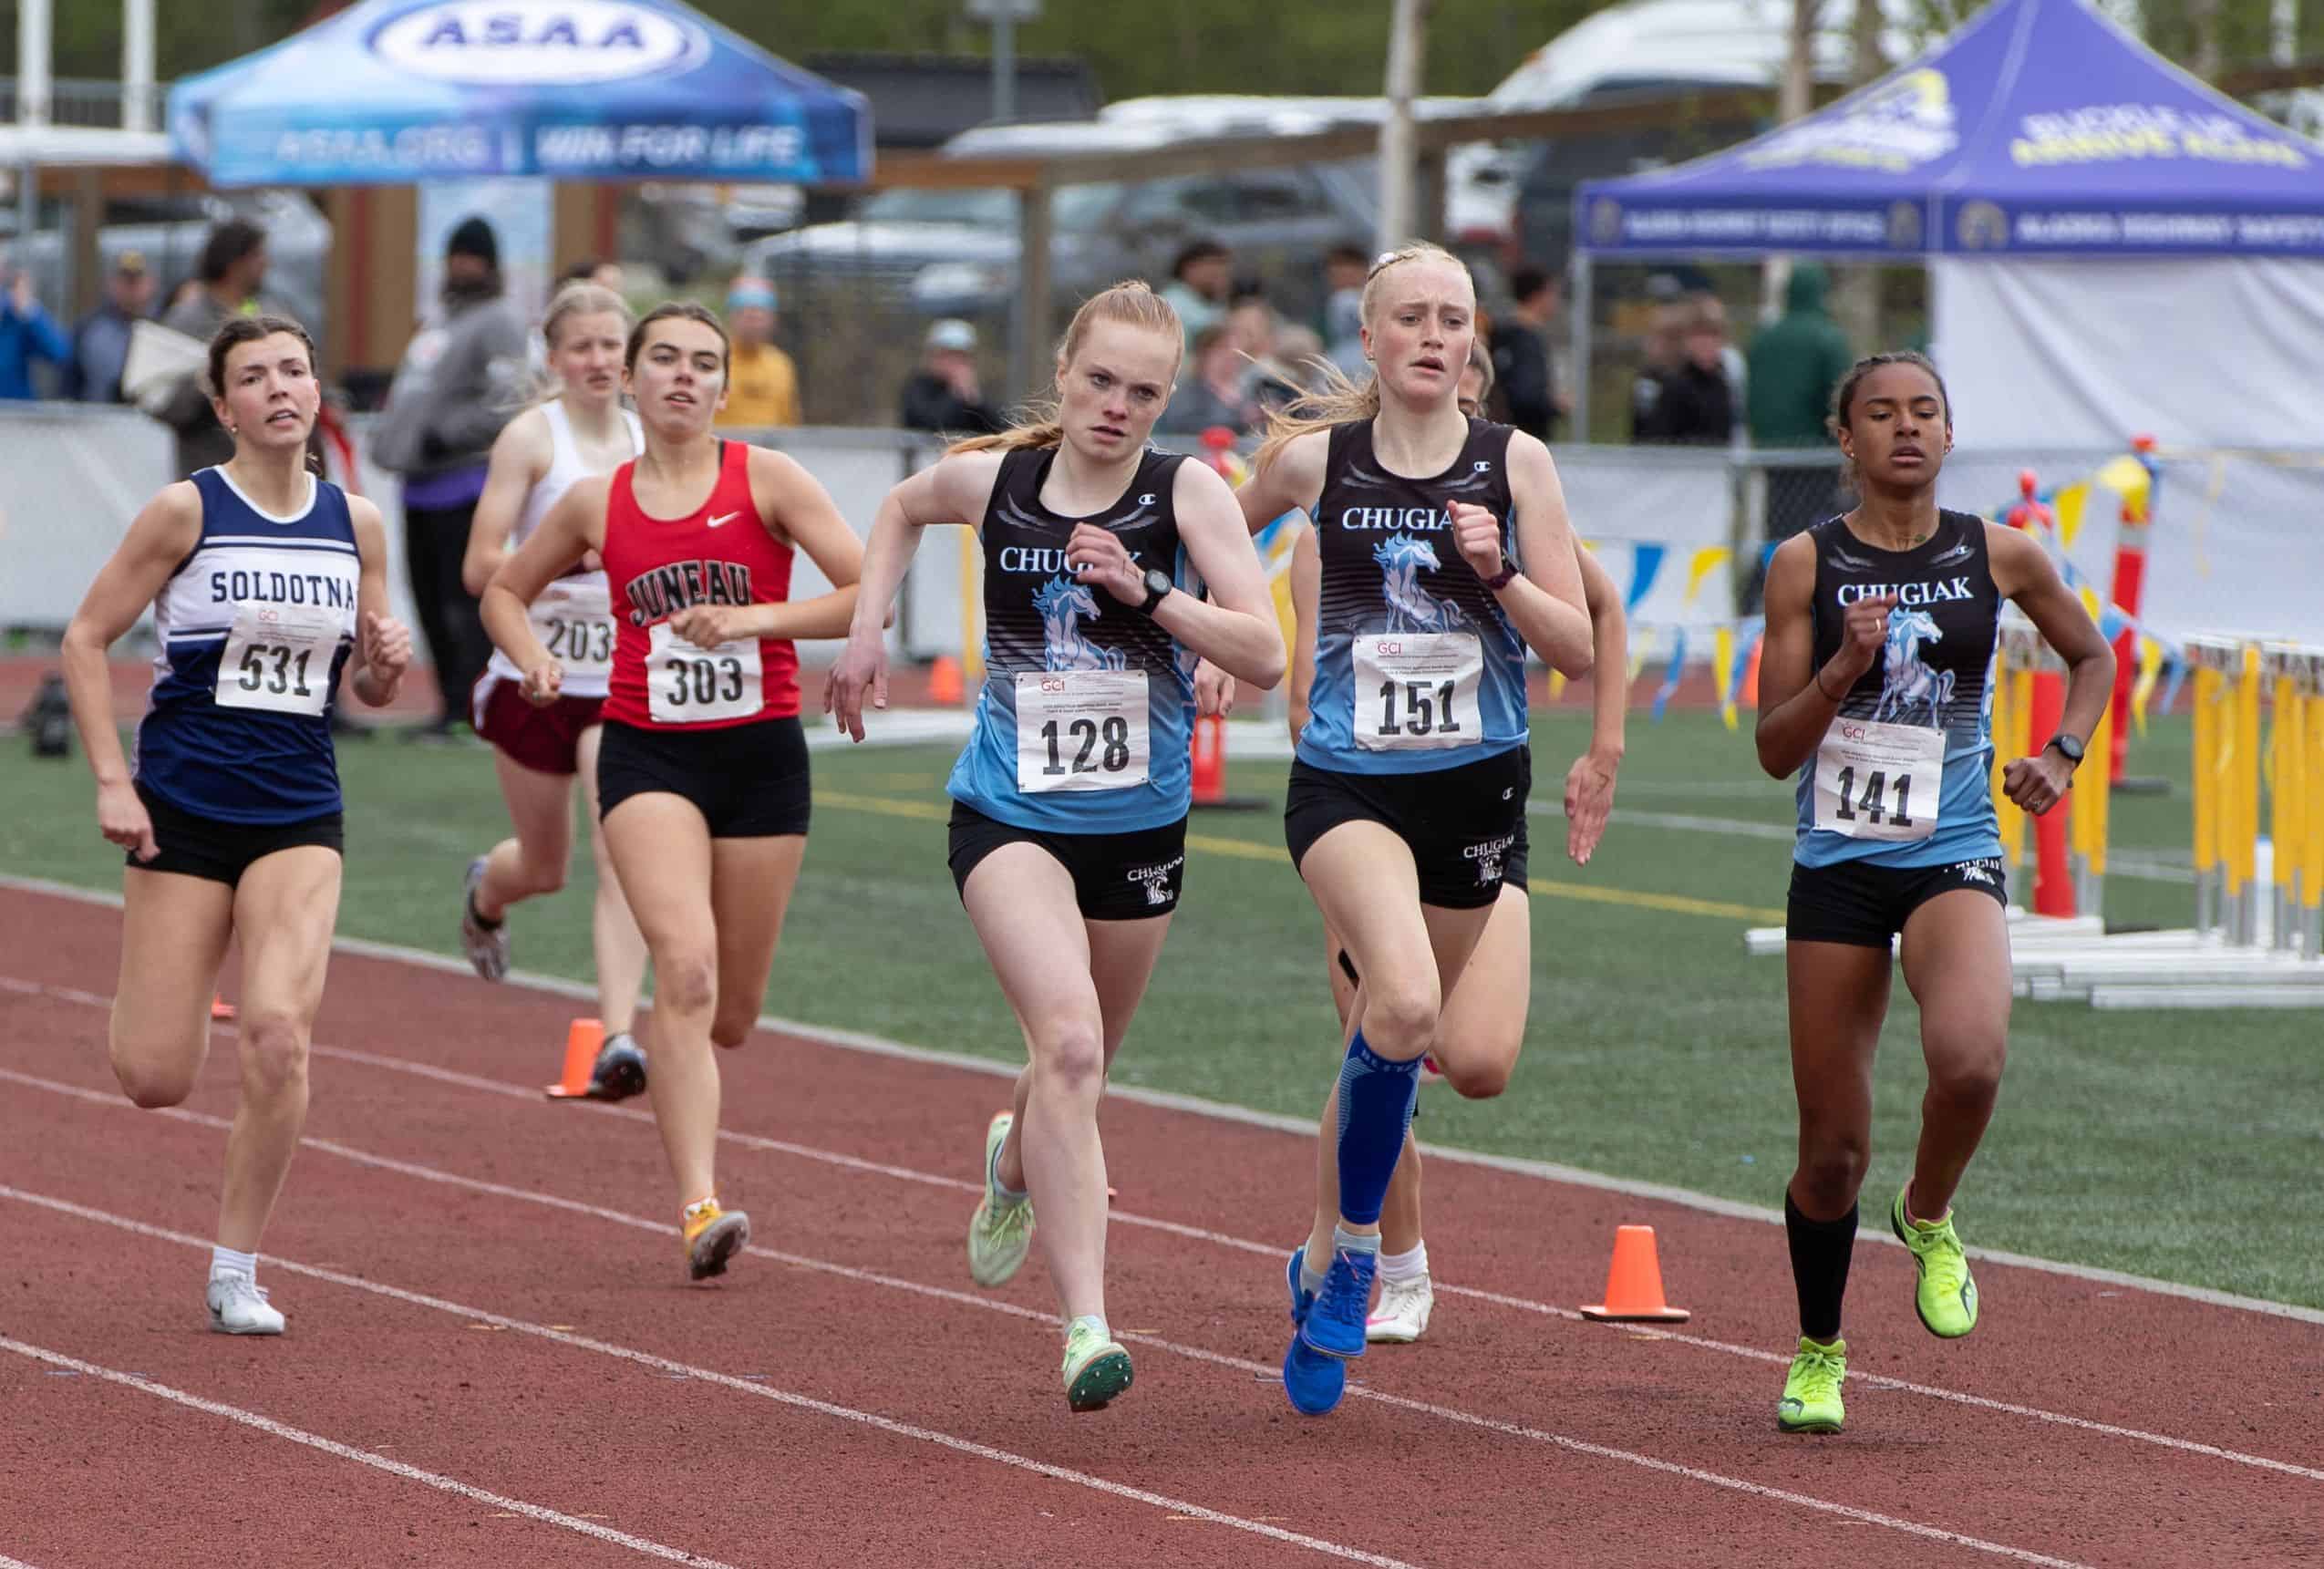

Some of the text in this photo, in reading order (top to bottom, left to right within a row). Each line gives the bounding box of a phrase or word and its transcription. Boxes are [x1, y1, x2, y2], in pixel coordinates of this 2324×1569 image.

[425, 12, 644, 48] ASAA
[617, 125, 708, 167] FOR
[709, 126, 805, 167] LIFE
[1341, 507, 1455, 531] CHUGIA
[211, 571, 356, 610] SOLDOTNA
[625, 560, 753, 627] JUNEAU
[1837, 577, 1975, 606] CHUGIAK
[545, 618, 611, 662] 203
[1378, 641, 1401, 655] GCI
[238, 644, 312, 697] 531
[665, 656, 744, 706] 303
[1041, 678, 1066, 692] GCI
[1377, 679, 1461, 736] 151
[1040, 716, 1131, 776] 128
[1842, 725, 1866, 741] GCI
[1835, 766, 1913, 828] 141
